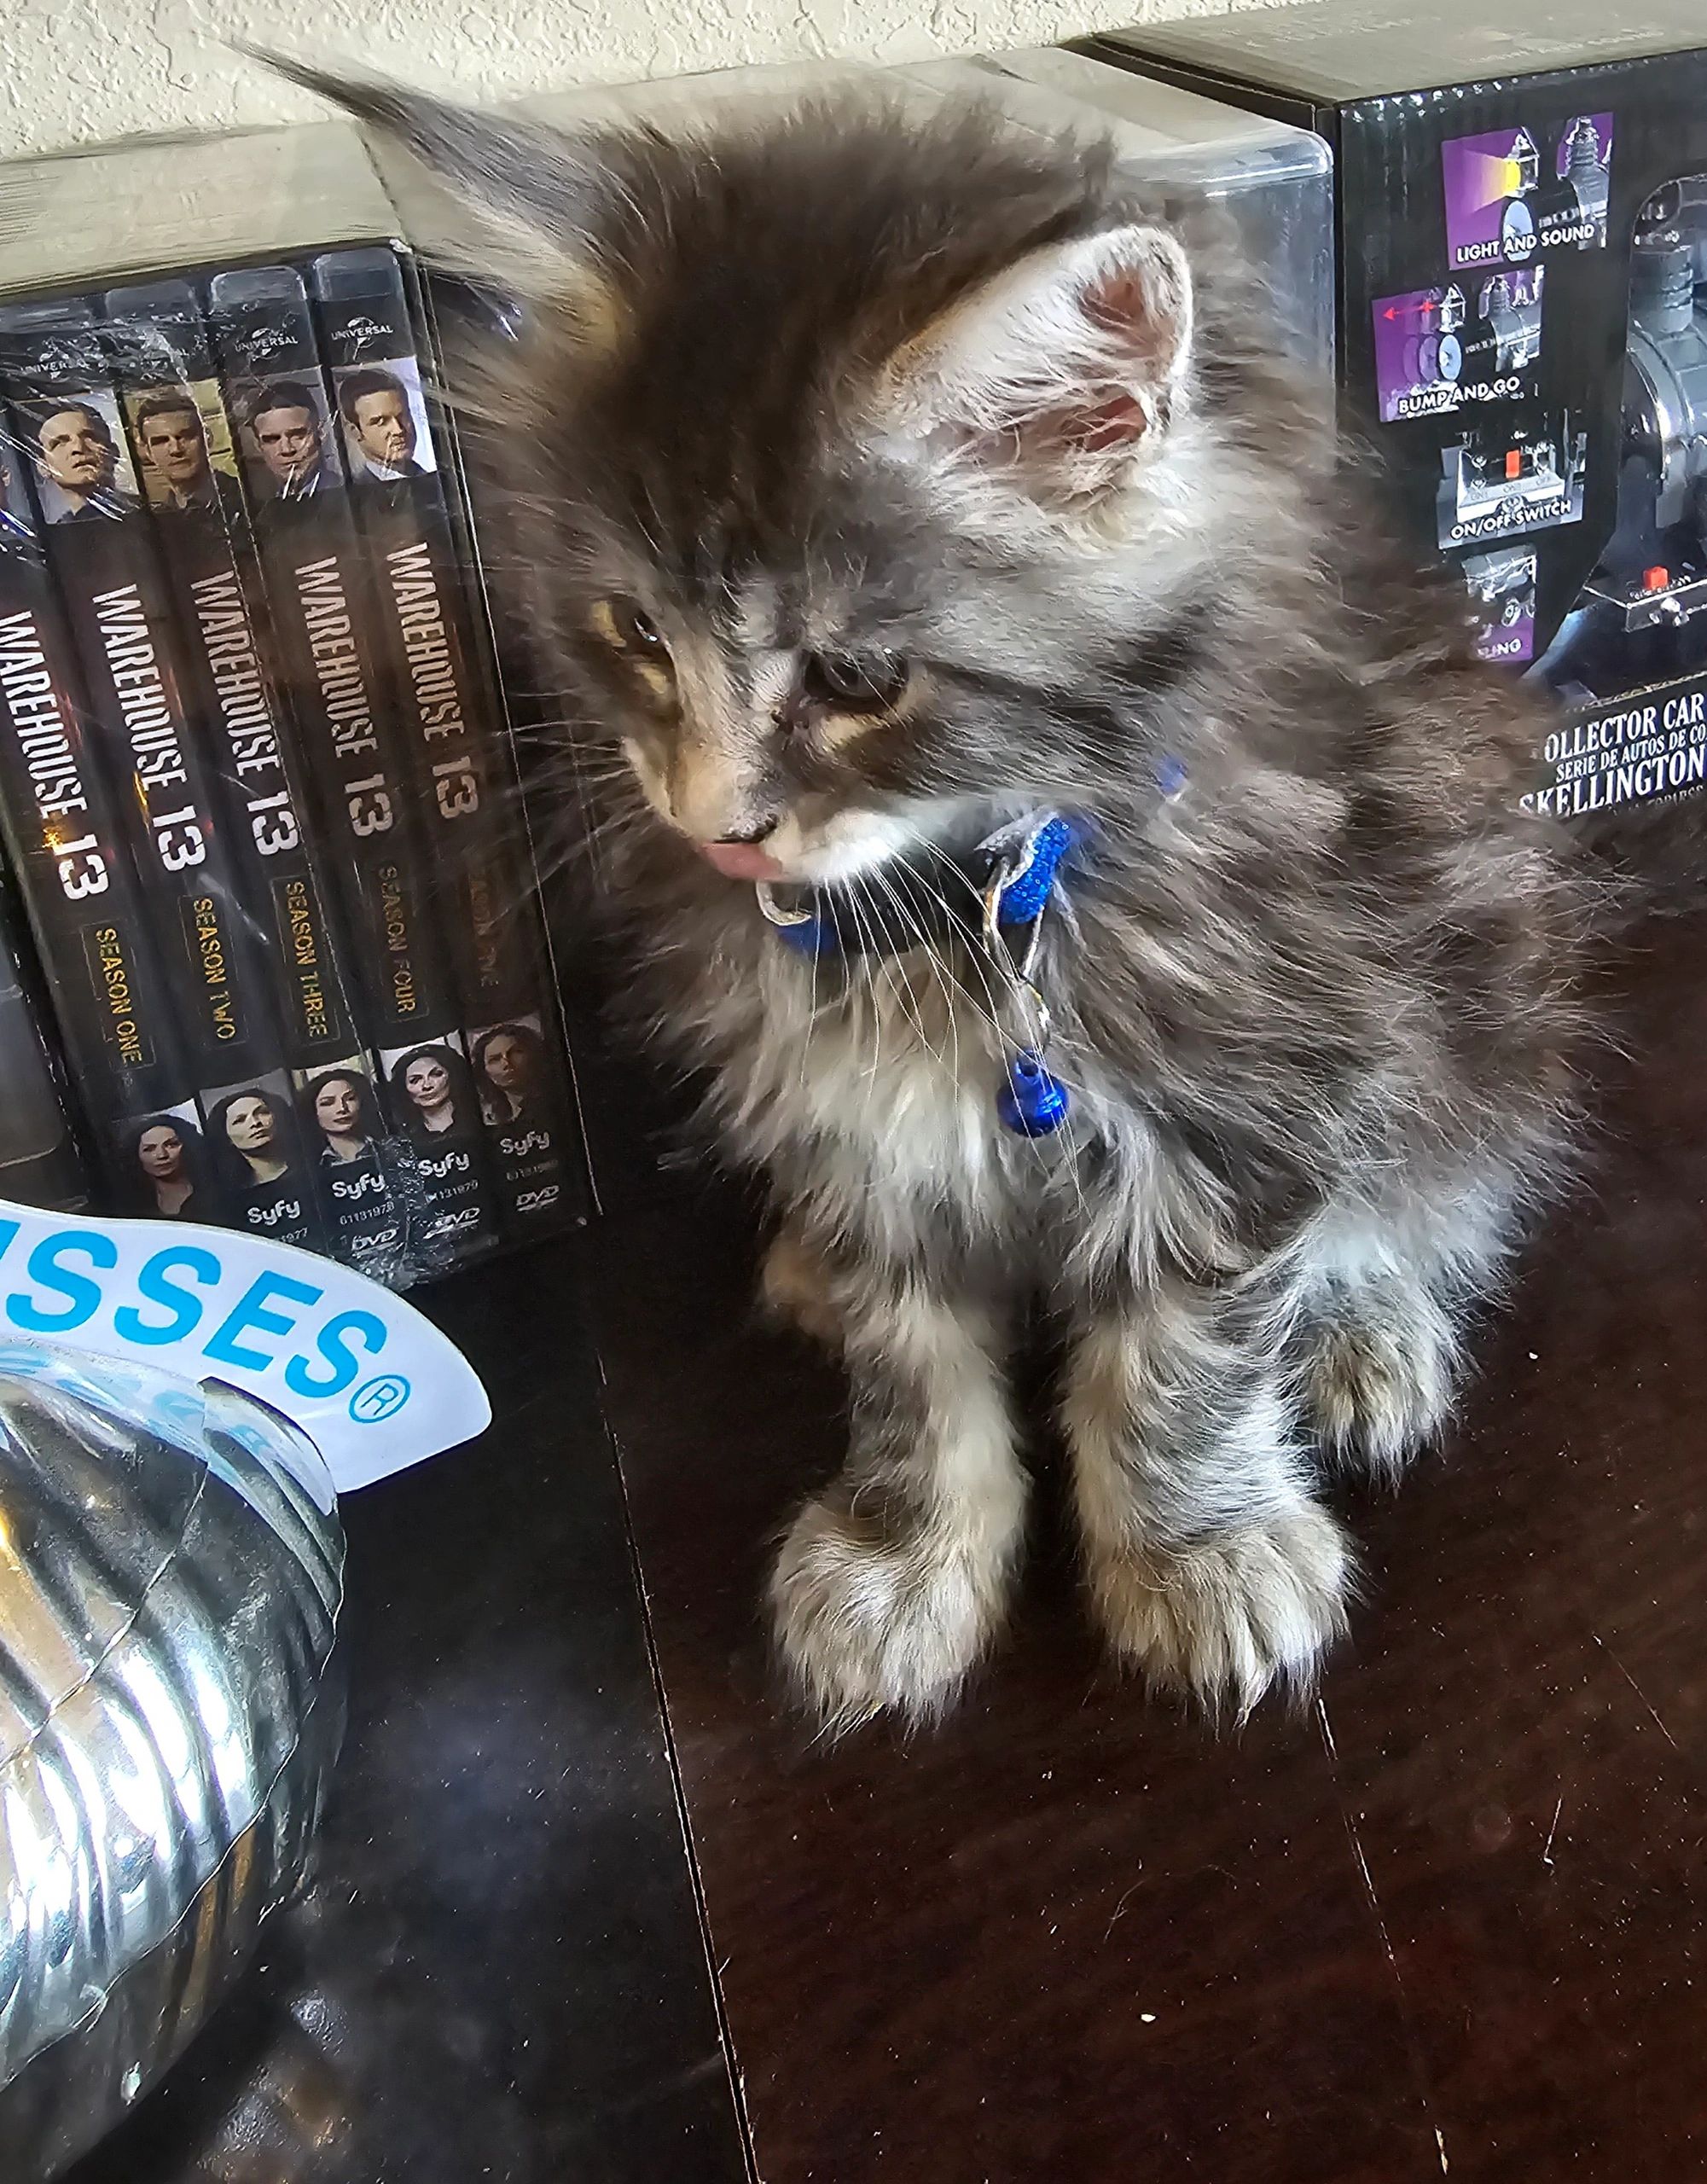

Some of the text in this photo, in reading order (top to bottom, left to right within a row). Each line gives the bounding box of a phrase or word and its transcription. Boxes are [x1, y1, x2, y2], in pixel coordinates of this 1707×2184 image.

[1456, 224, 1595, 263] LIGHT AND SOUND
[235, 334, 299, 352] UNIVERSAL
[330, 324, 394, 341] UNIVERSAL
[1399, 375, 1520, 414] BUMP AND GO
[1450, 499, 1571, 539] ON/OFF SWITCH
[294, 555, 394, 838] WAREHOUSE 13
[386, 541, 479, 820] WAREHOUSE 13
[92, 583, 209, 873] WAREHOUSE 13
[190, 569, 300, 856] WAREHOUSE 13
[1544, 693, 1705, 763] OLLECTOR CAR
[0, 610, 111, 901] WAREHOUSE 13
[1519, 744, 1707, 817] SKELLINGTON
[1555, 723, 1707, 783] SERIE DE AUTOS DE CO
[193, 897, 237, 1041] SEASON TWO
[284, 880, 329, 1038] SEASON THREE
[378, 864, 419, 1015] SEASON FOUR
[96, 927, 142, 1065] SEASON ONE
[418, 1152, 470, 1178] Syfy
[499, 1130, 550, 1156] Syfy
[247, 1199, 301, 1226] Syfy
[332, 1172, 385, 1200] Syfy
[515, 1185, 560, 1206] DVD
[351, 1226, 400, 1252] DVD
